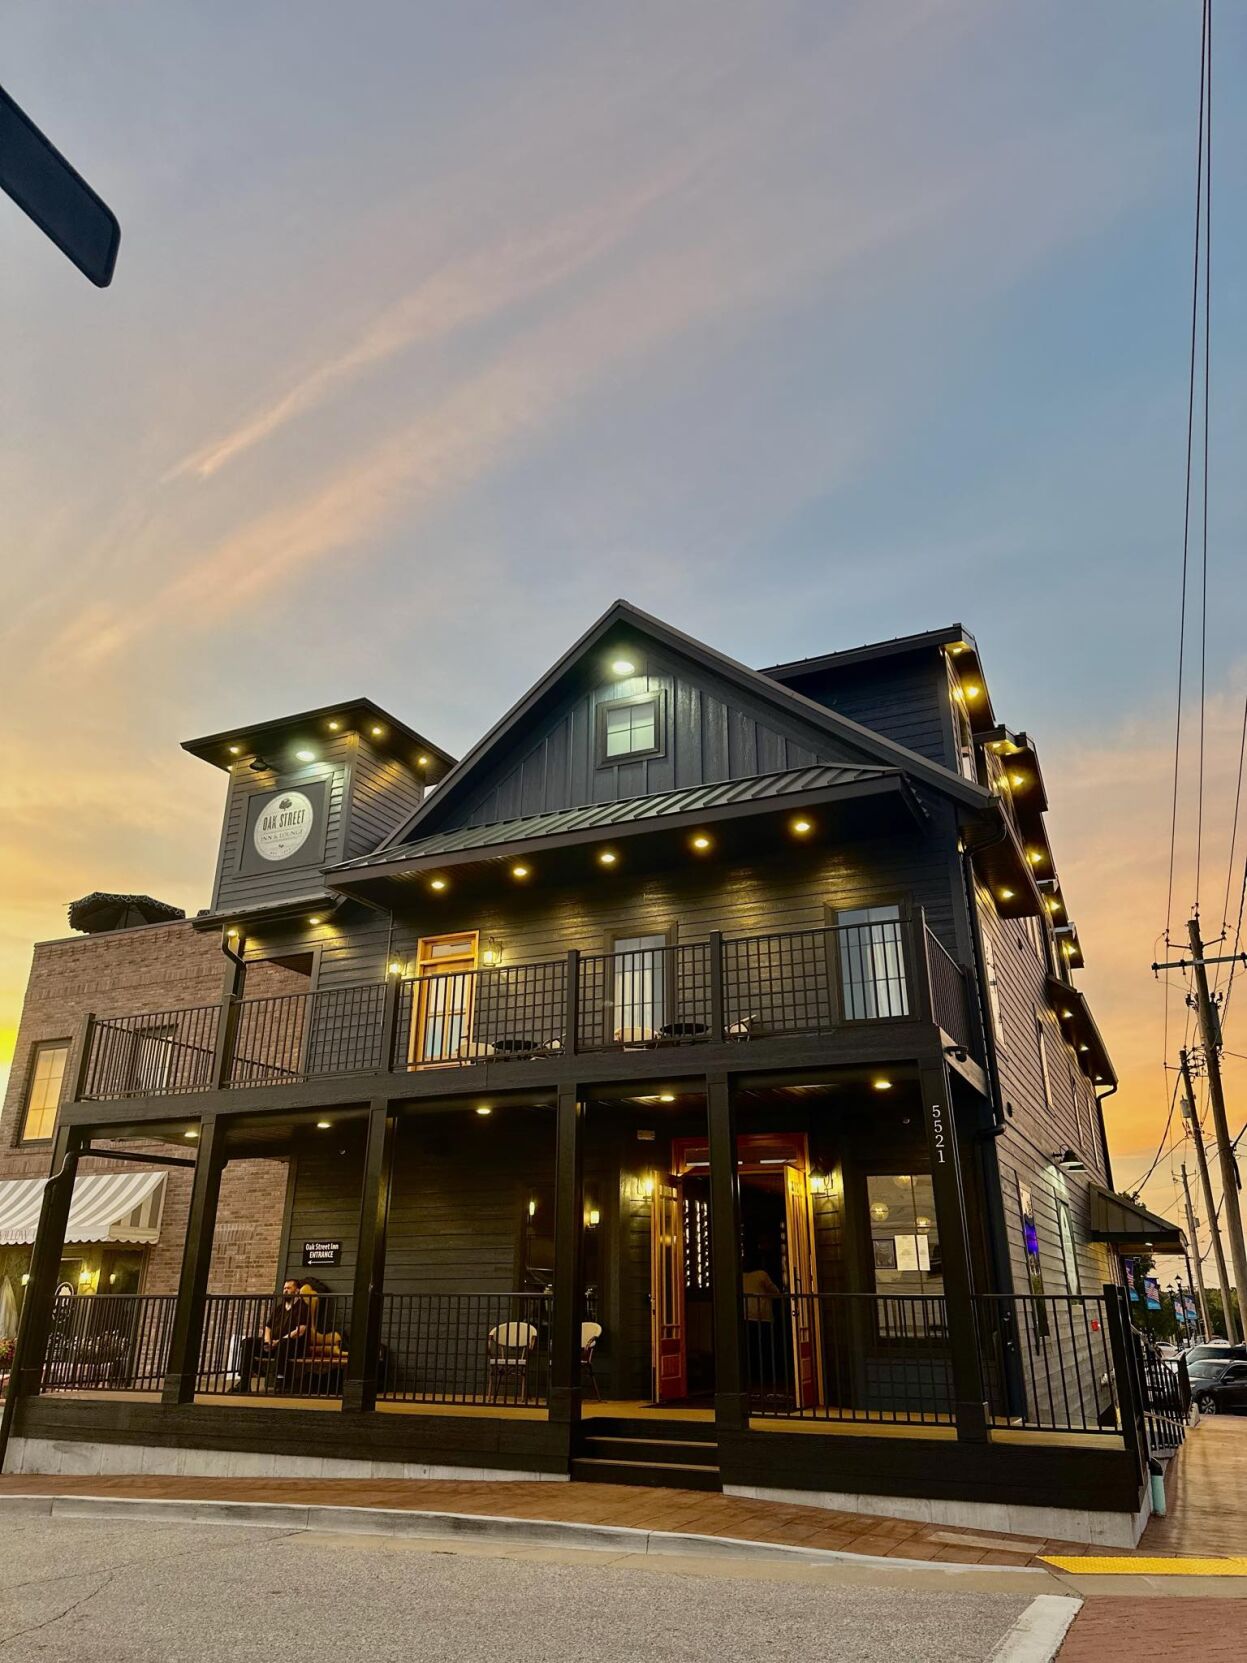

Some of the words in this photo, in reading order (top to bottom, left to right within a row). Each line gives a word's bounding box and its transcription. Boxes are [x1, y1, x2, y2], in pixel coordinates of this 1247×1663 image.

[262, 815, 278, 831] OAK
[279, 810, 306, 828] STREET
[932, 1104, 946, 1163] 5521
